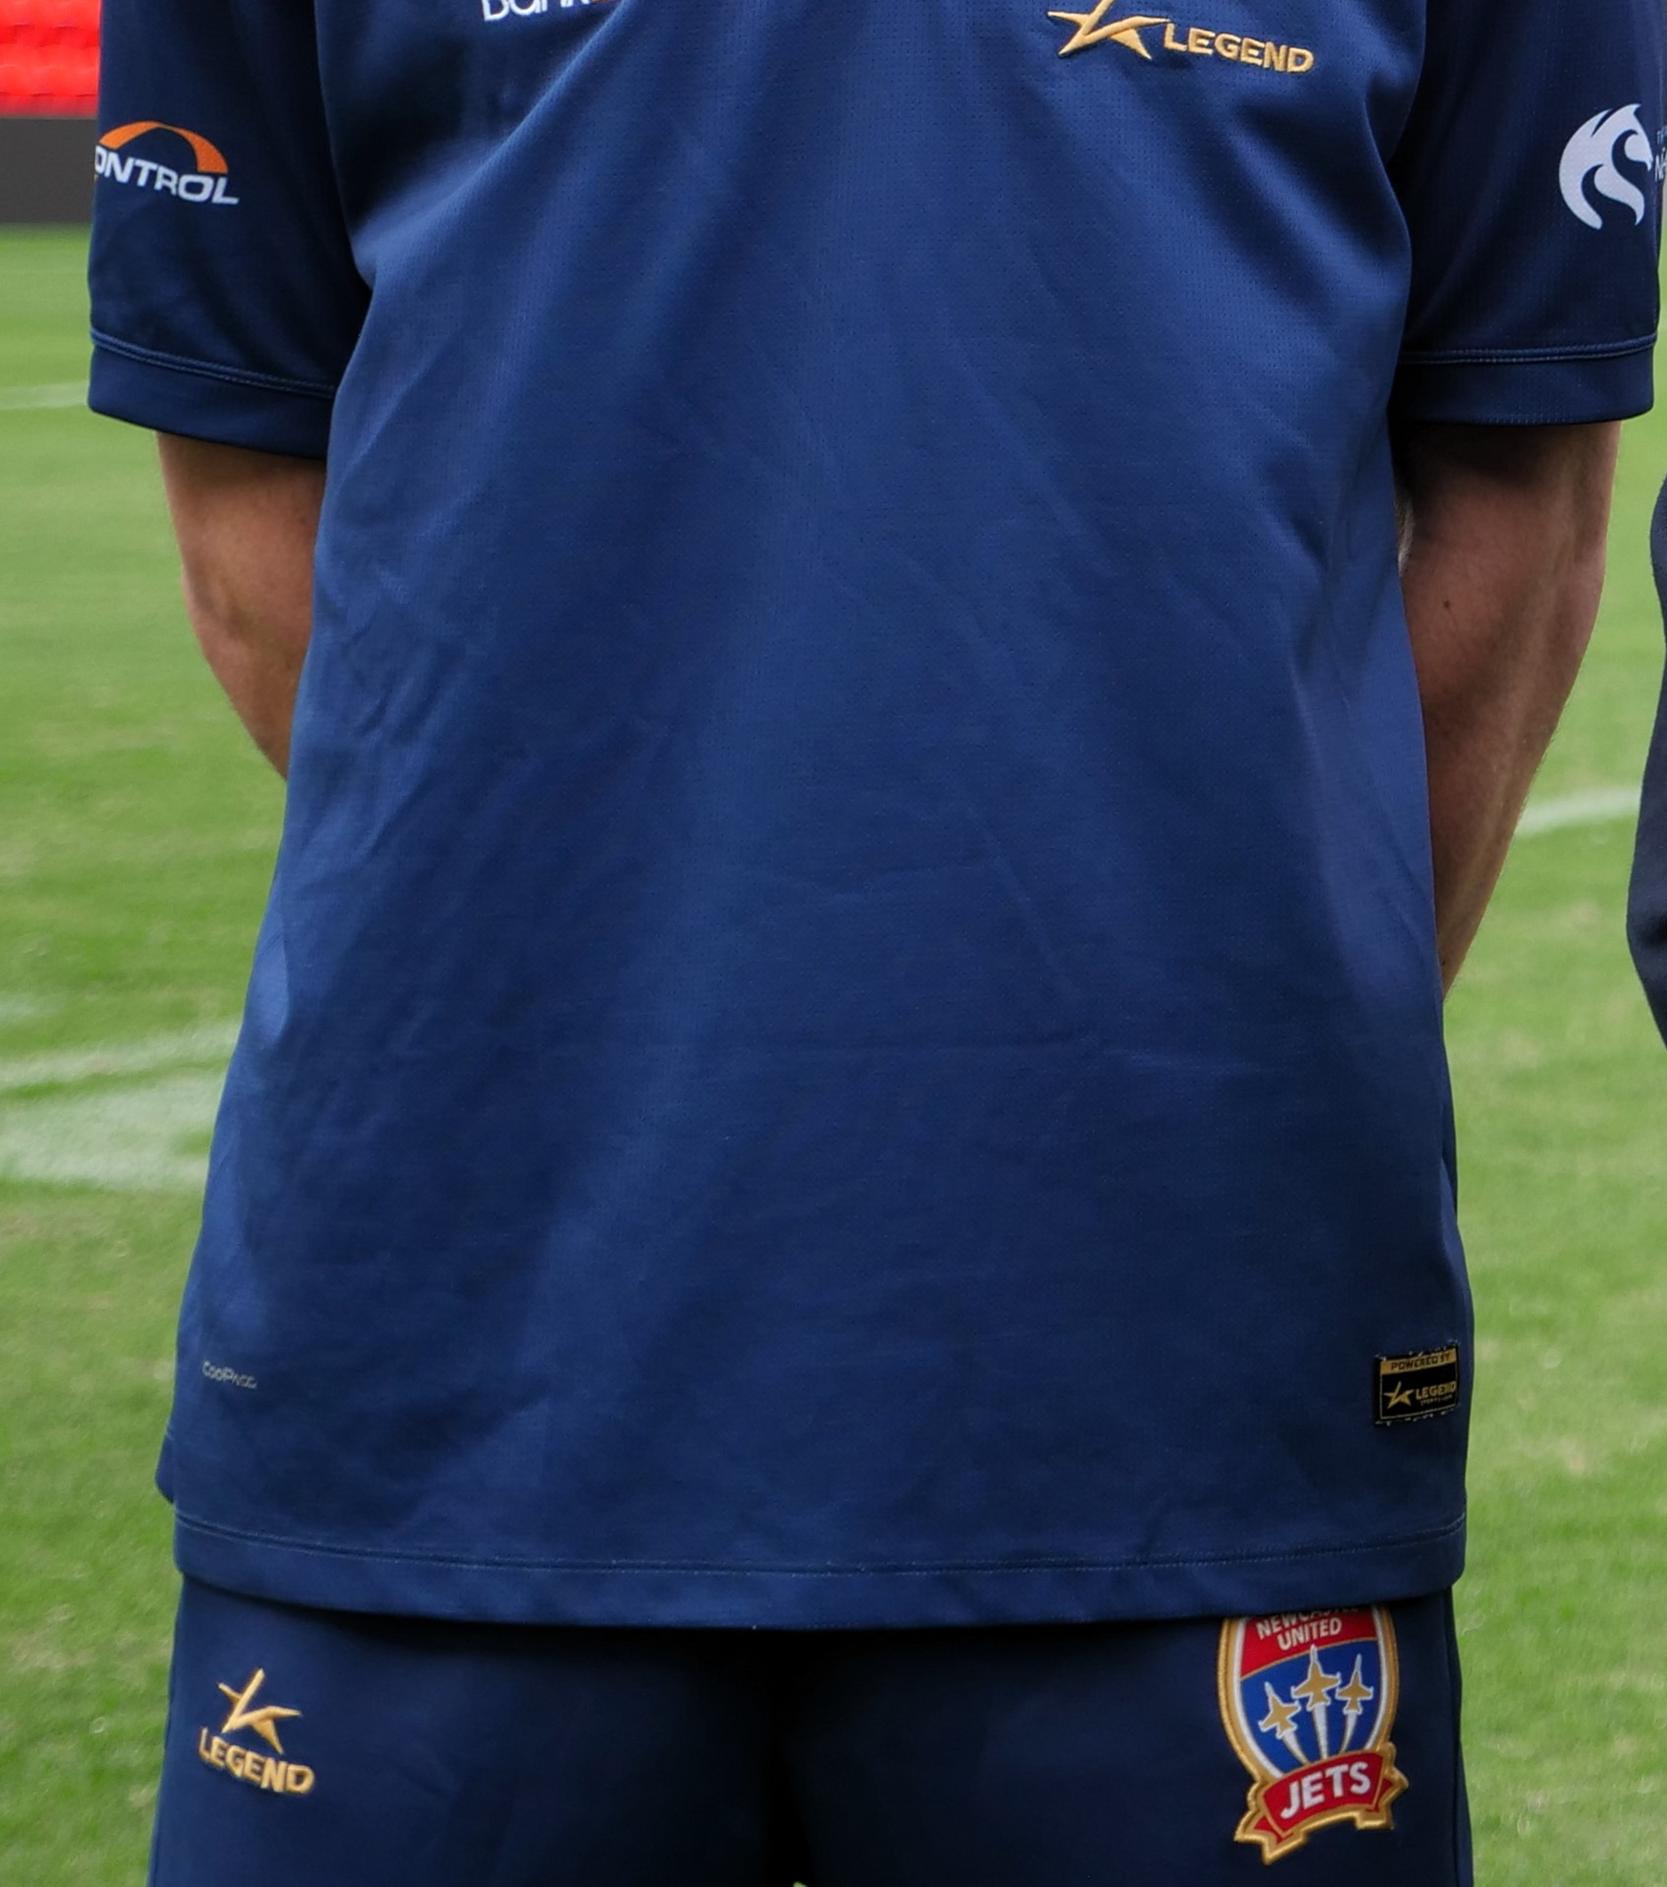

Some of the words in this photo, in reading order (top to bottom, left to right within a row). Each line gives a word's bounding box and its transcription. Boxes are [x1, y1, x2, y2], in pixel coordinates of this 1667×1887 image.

[1163, 22, 1314, 73] LEGEND
[1277, 1616, 1342, 1651] UNITED
[198, 1727, 316, 1794] LEGEND
[1280, 1761, 1370, 1820] JETS
